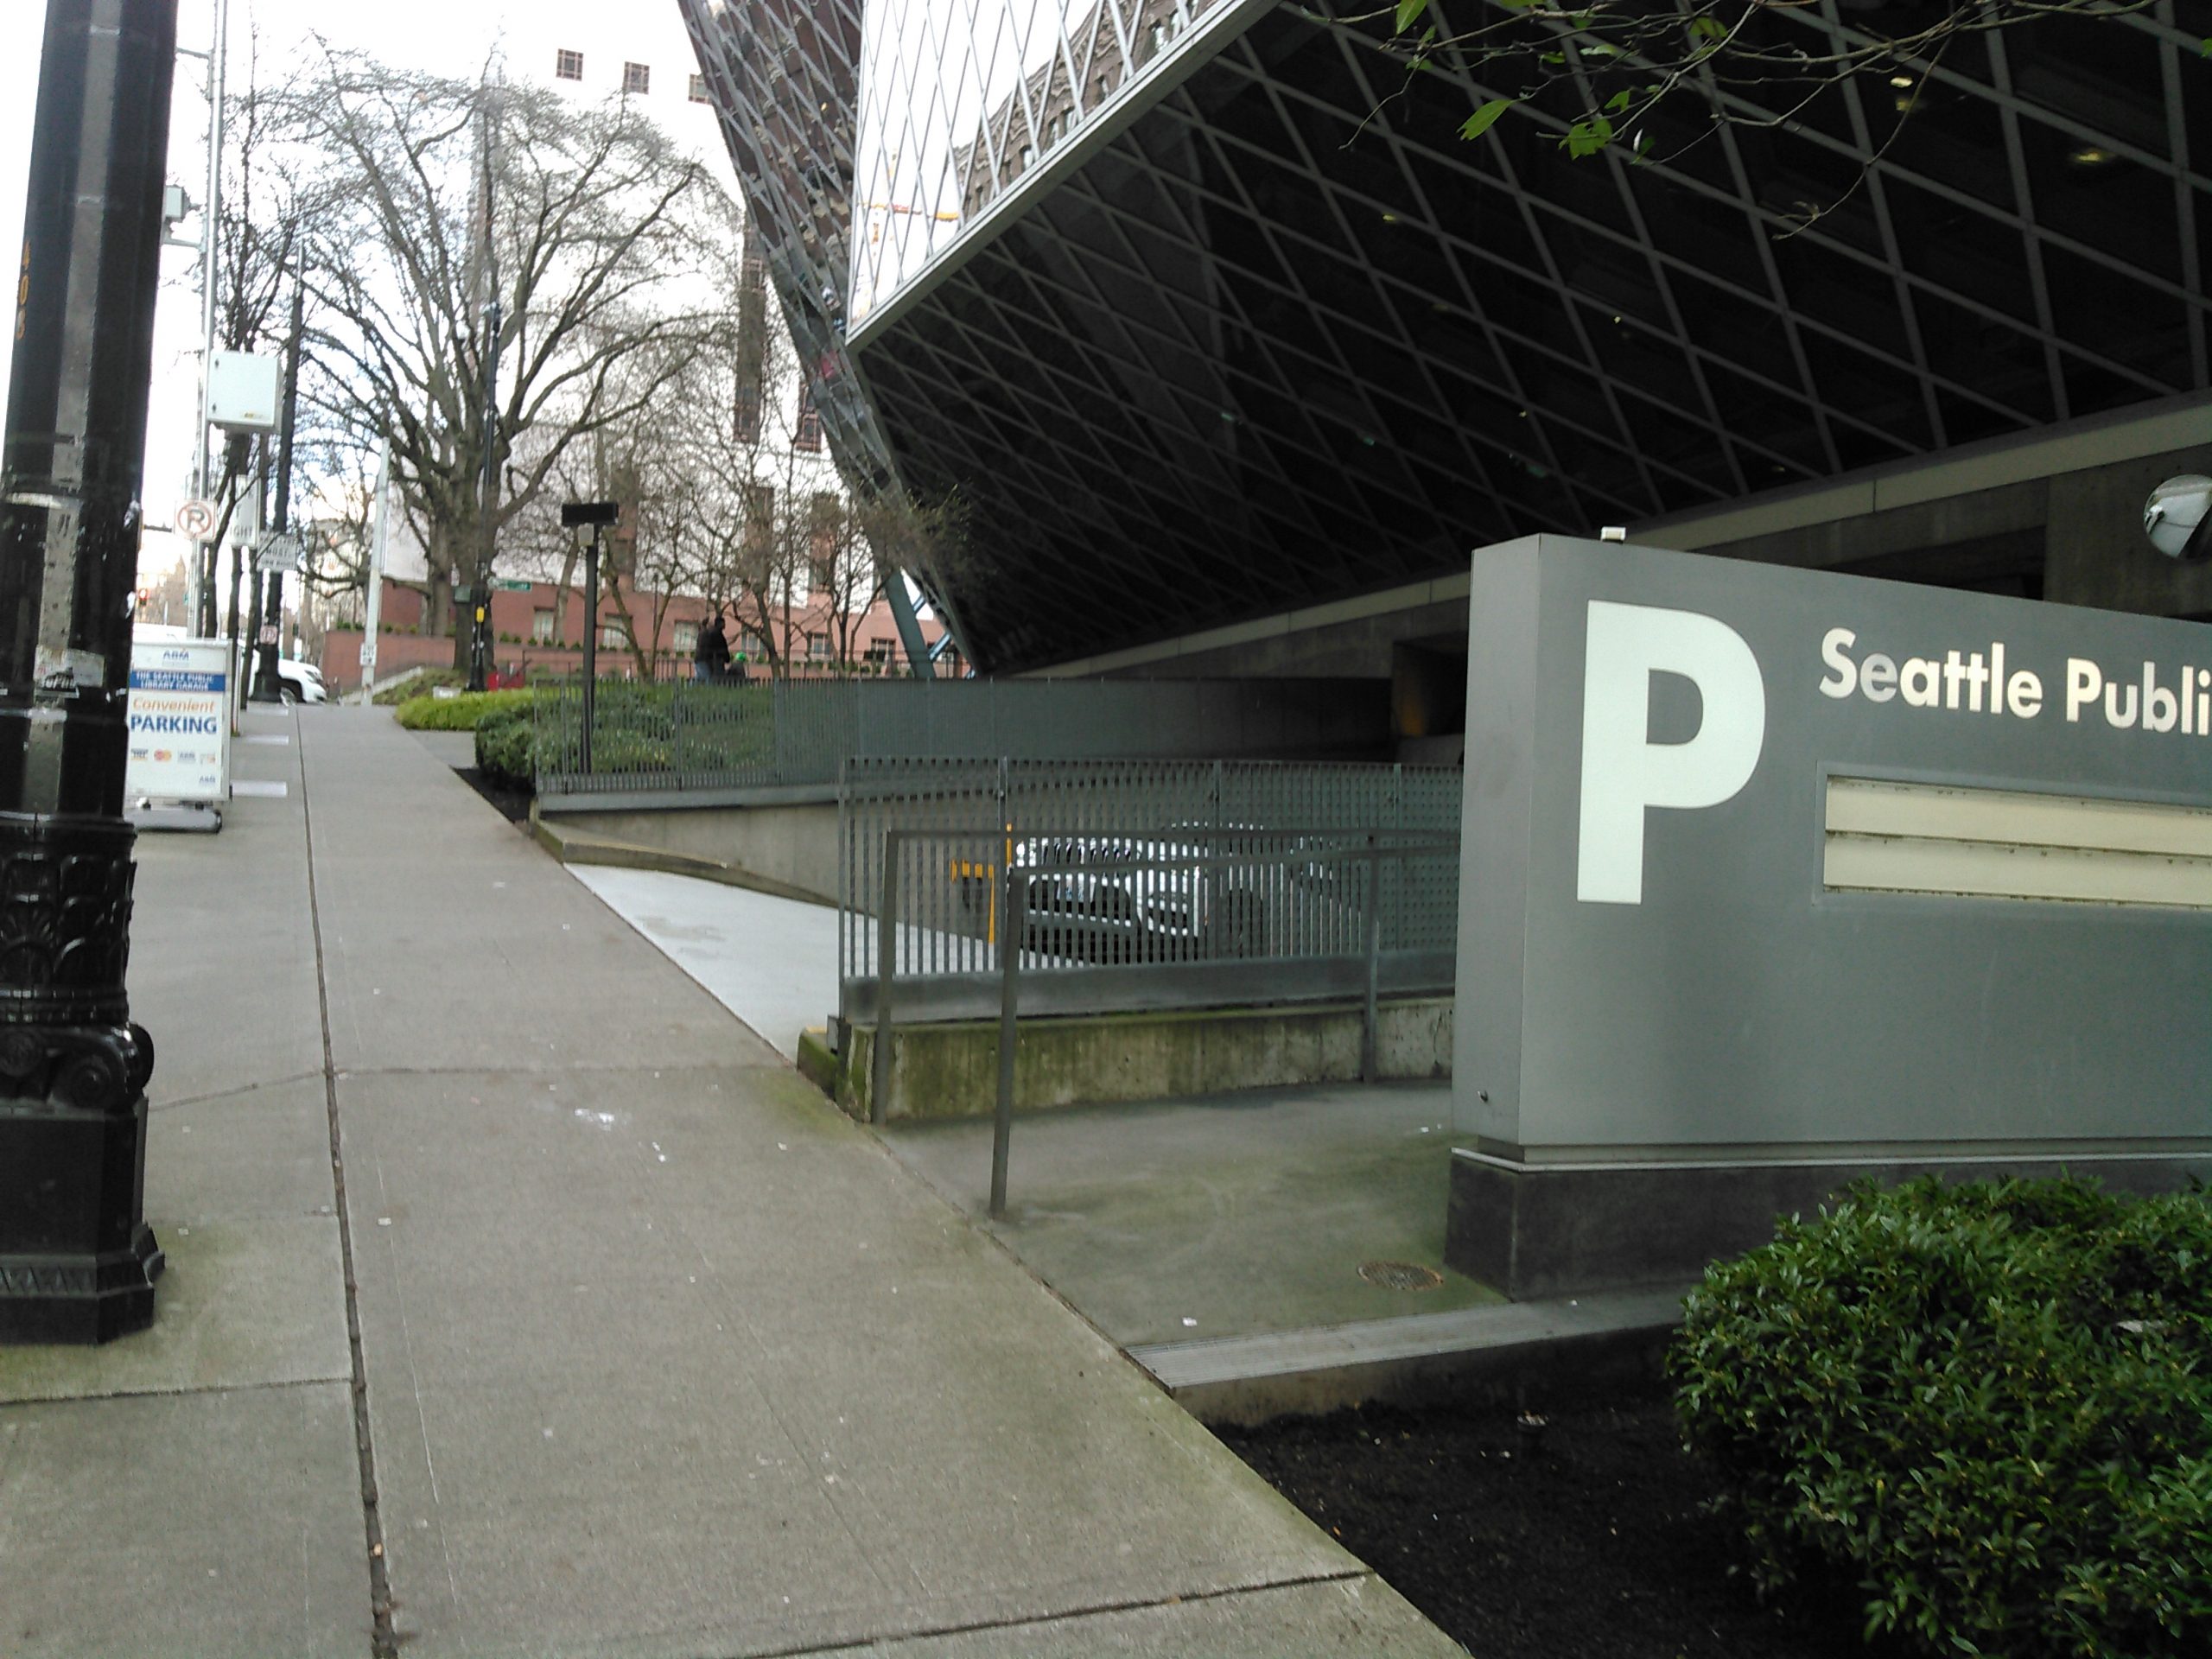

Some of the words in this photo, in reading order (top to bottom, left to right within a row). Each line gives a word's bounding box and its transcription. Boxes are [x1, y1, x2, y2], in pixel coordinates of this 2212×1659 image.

[133, 697, 215, 713] Convenient
[1819, 627, 2043, 719] Seattle
[2066, 657, 2210, 736] Publi
[130, 714, 217, 734] PARKING
[1577, 599, 1766, 906] P
